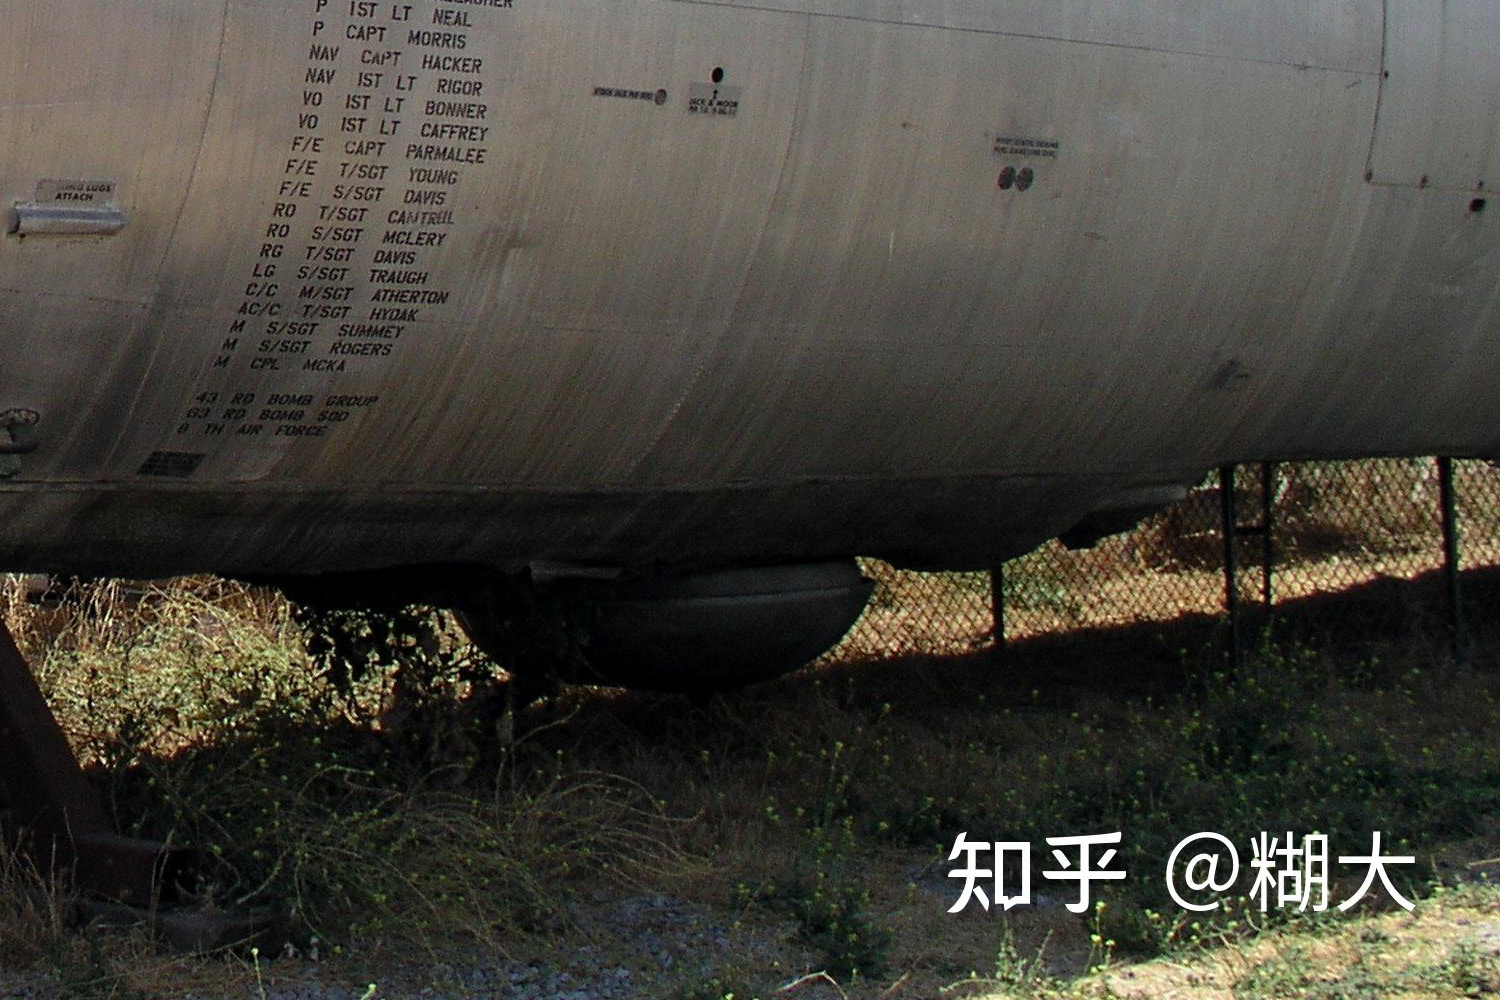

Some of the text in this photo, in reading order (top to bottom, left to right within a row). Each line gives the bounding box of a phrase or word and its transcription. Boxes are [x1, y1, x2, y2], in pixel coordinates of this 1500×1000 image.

[392, 5, 412, 21] LT
[432, 8, 472, 27] NEAL
[313, 21, 466, 49] P CAPT MORRIS
[309, 44, 482, 73] NAV CAPT HACKER
[305, 68, 336, 84] NAV
[396, 75, 417, 91] LT
[437, 78, 483, 97] RIGOR
[303, 90, 323, 107] VO
[384, 97, 405, 113] LT
[425, 100, 487, 119] BONNER
[299, 113, 318, 129] VO
[379, 119, 401, 135] LT
[421, 123, 489, 141] CAFFREY
[292, 136, 487, 164] F/E CAPT PARMALEE
[285, 159, 458, 185] F/E T/SGT YOUNG
[279, 181, 447, 206] F/E S/SGT DAVIS
[273, 203, 296, 218] RO
[320, 205, 369, 222] T/SGT
[266, 223, 290, 238] RO
[312, 226, 364, 242] S/SGT
[306, 246, 355, 262] T/SGT
[373, 250, 416, 265] DAVIS
[253, 263, 428, 285] LG S/SGT TRAUGH
[298, 286, 354, 301] M/SGT
[371, 289, 449, 304] ATHERTON
[302, 304, 352, 320] T/SGT
[229, 319, 405, 339] M S/SGT SUMMEY
[222, 337, 393, 356] M S/SGT ROGERS
[213, 355, 230, 368] M
[250, 356, 280, 370] CPL
